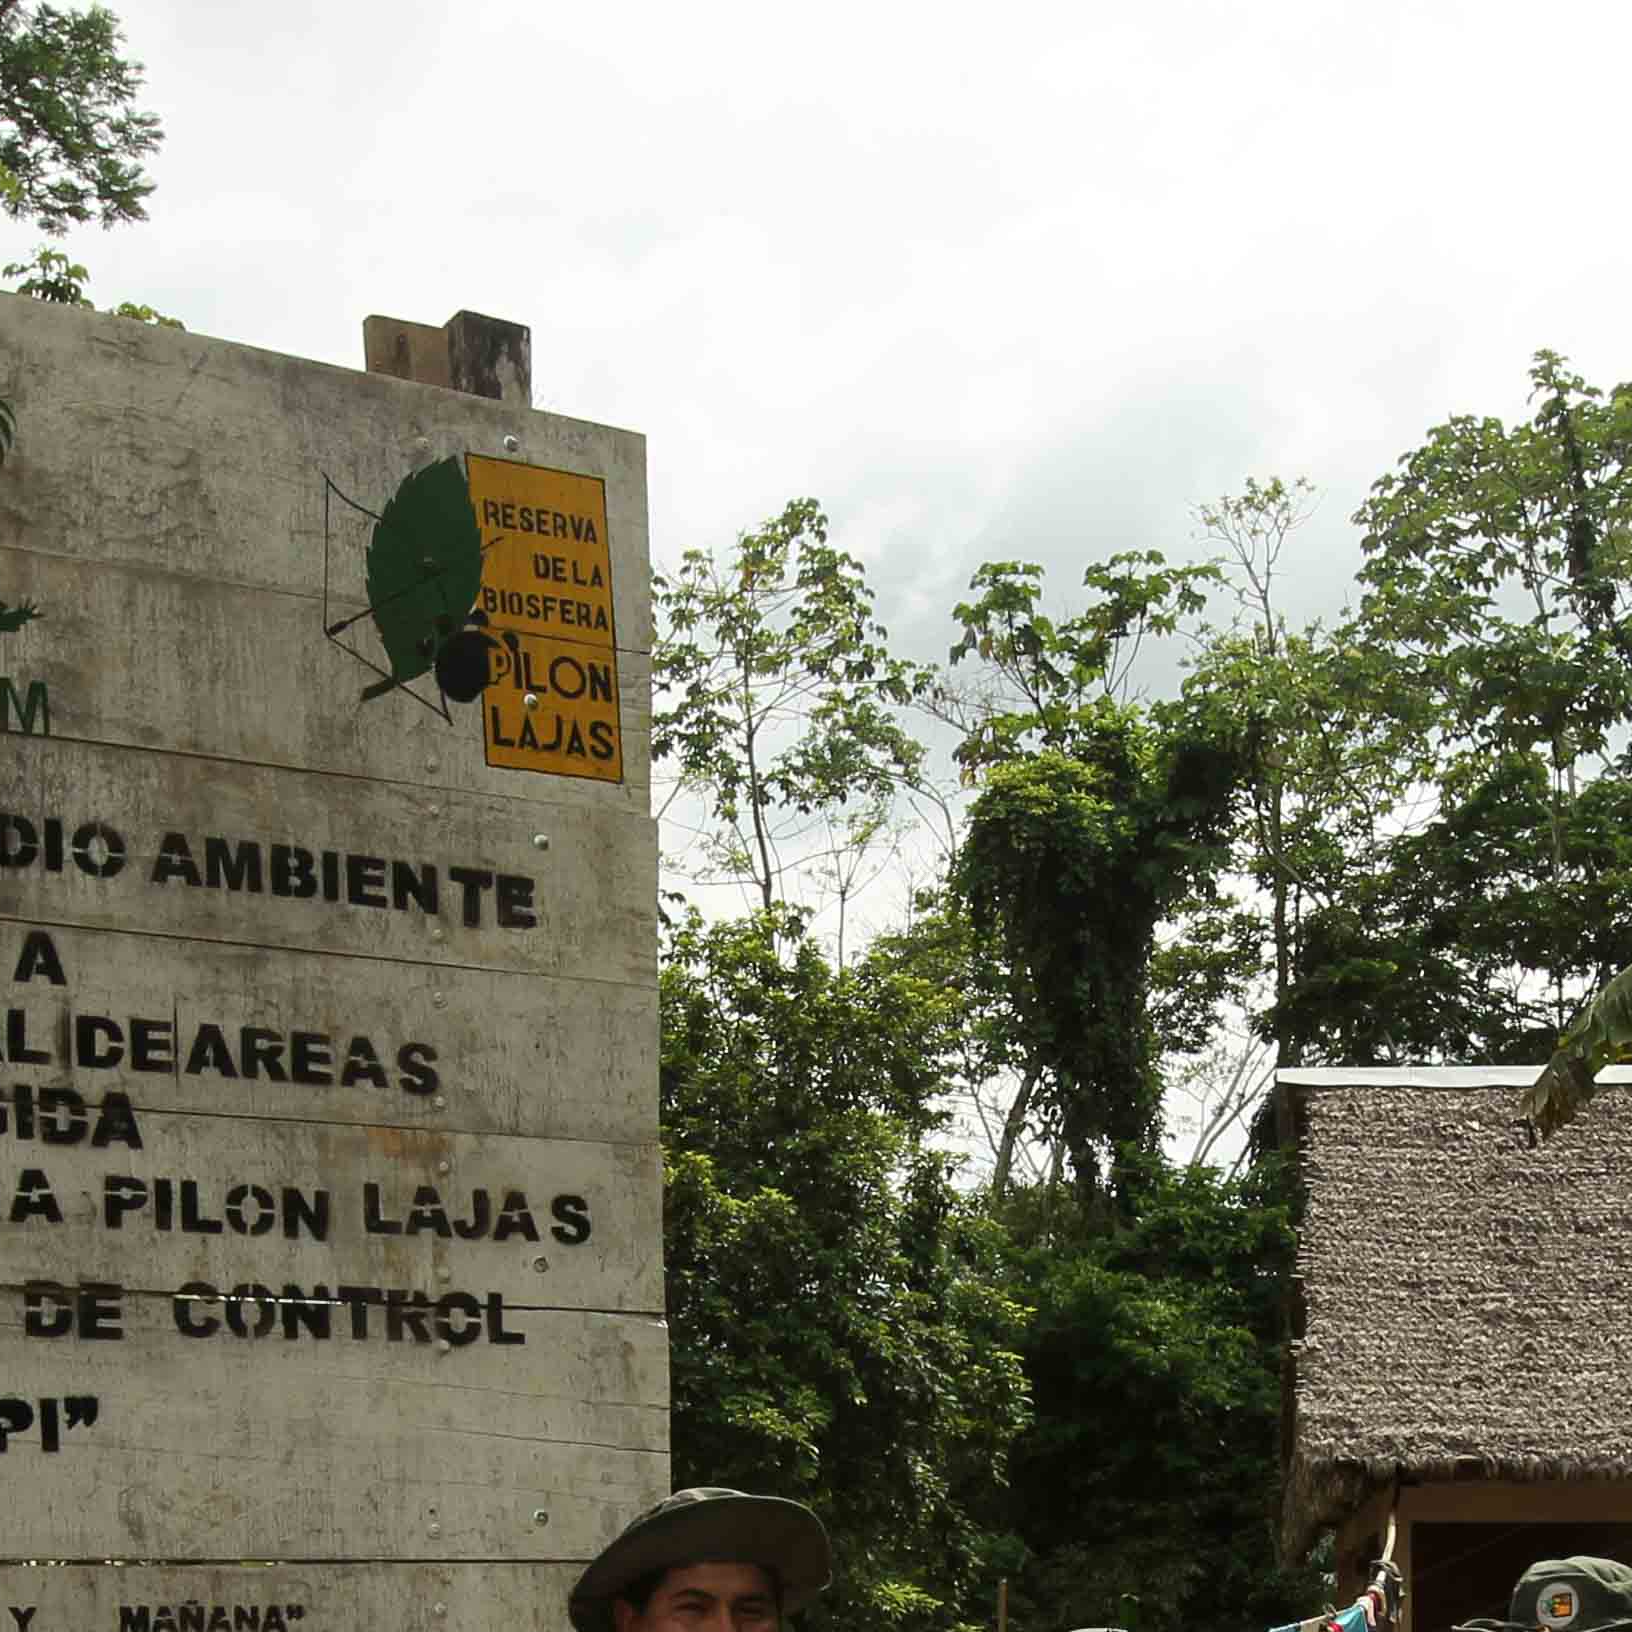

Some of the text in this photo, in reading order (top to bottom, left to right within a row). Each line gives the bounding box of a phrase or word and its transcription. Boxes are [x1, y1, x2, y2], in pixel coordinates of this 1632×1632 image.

[484, 498, 597, 545] RESERVA
[533, 553, 604, 588] DE LA
[483, 586, 609, 632] BIOSFERA
[488, 638, 613, 703] PILON
[491, 705, 615, 761] LAJAS
[150, 830, 537, 929] AMBIENTE
[103, 1174, 330, 1241] PILON
[362, 1183, 592, 1245] LAJAS
[24, 1281, 124, 1340] DE
[172, 1281, 526, 1346] CONTROL
